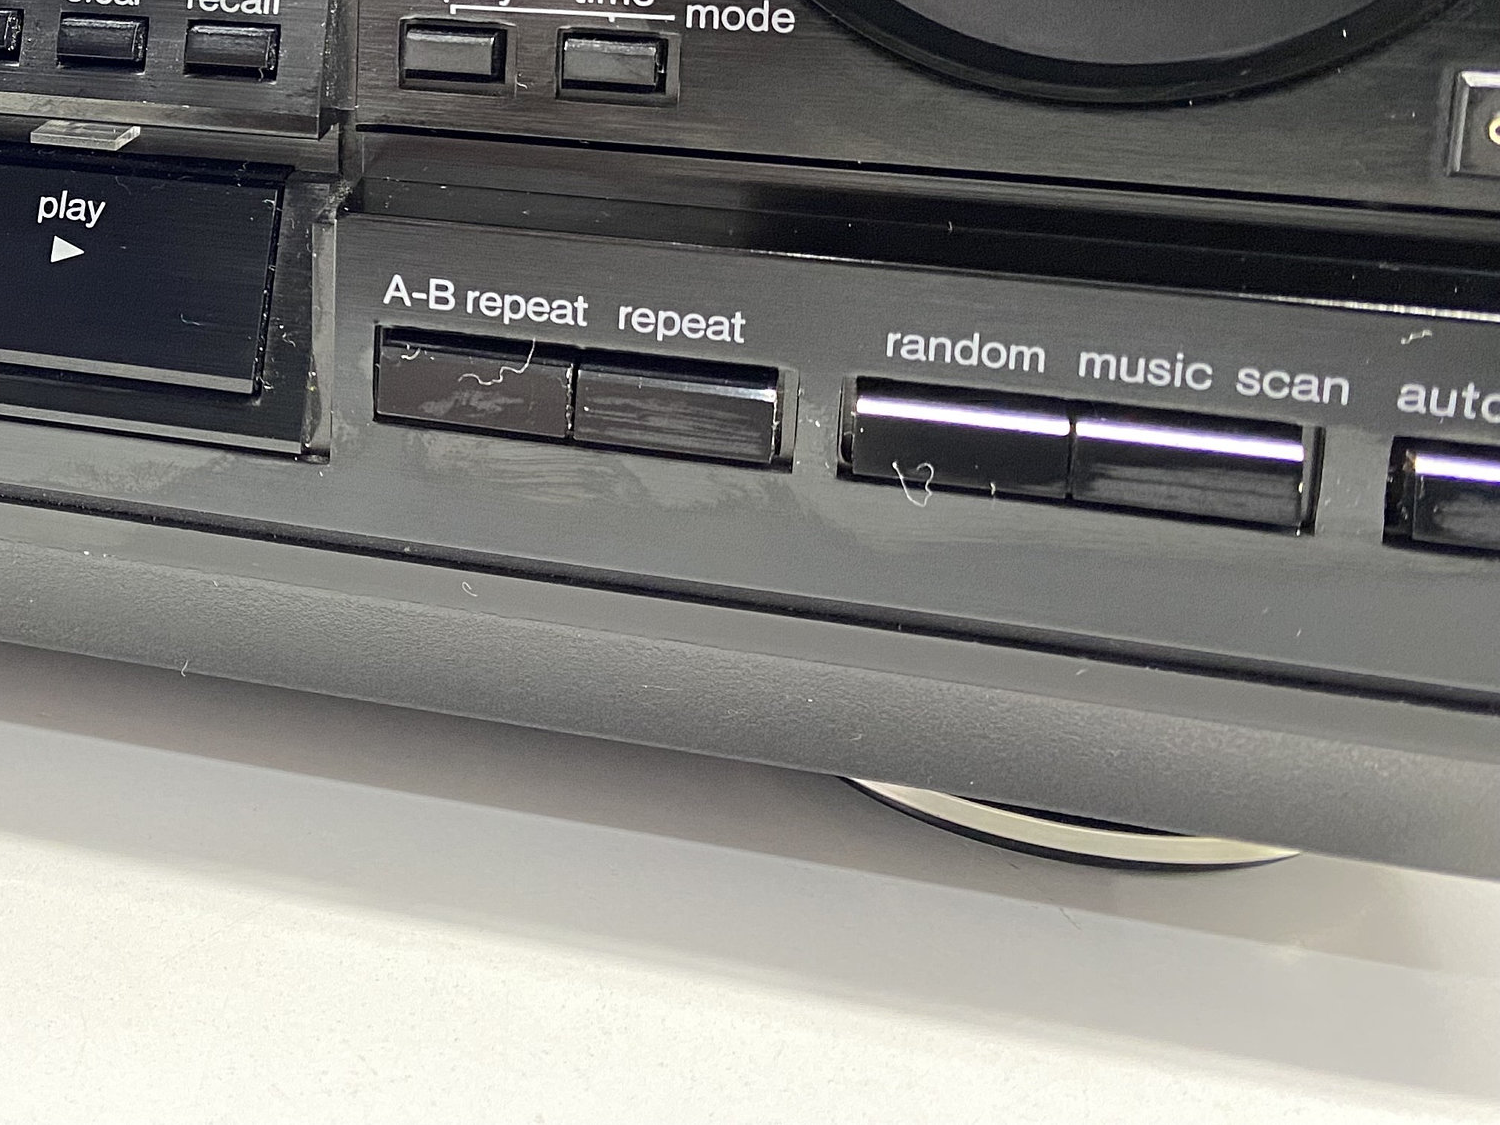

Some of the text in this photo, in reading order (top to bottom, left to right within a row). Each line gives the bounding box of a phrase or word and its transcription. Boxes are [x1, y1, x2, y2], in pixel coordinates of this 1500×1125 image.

[686, 1, 796, 34] mode
[37, 189, 106, 228] play
[382, 274, 588, 326] A-B repeat
[618, 303, 746, 343] repeat
[886, 332, 1046, 374] random
[1077, 349, 1350, 406] music scan
[1397, 382, 1500, 422] auto
